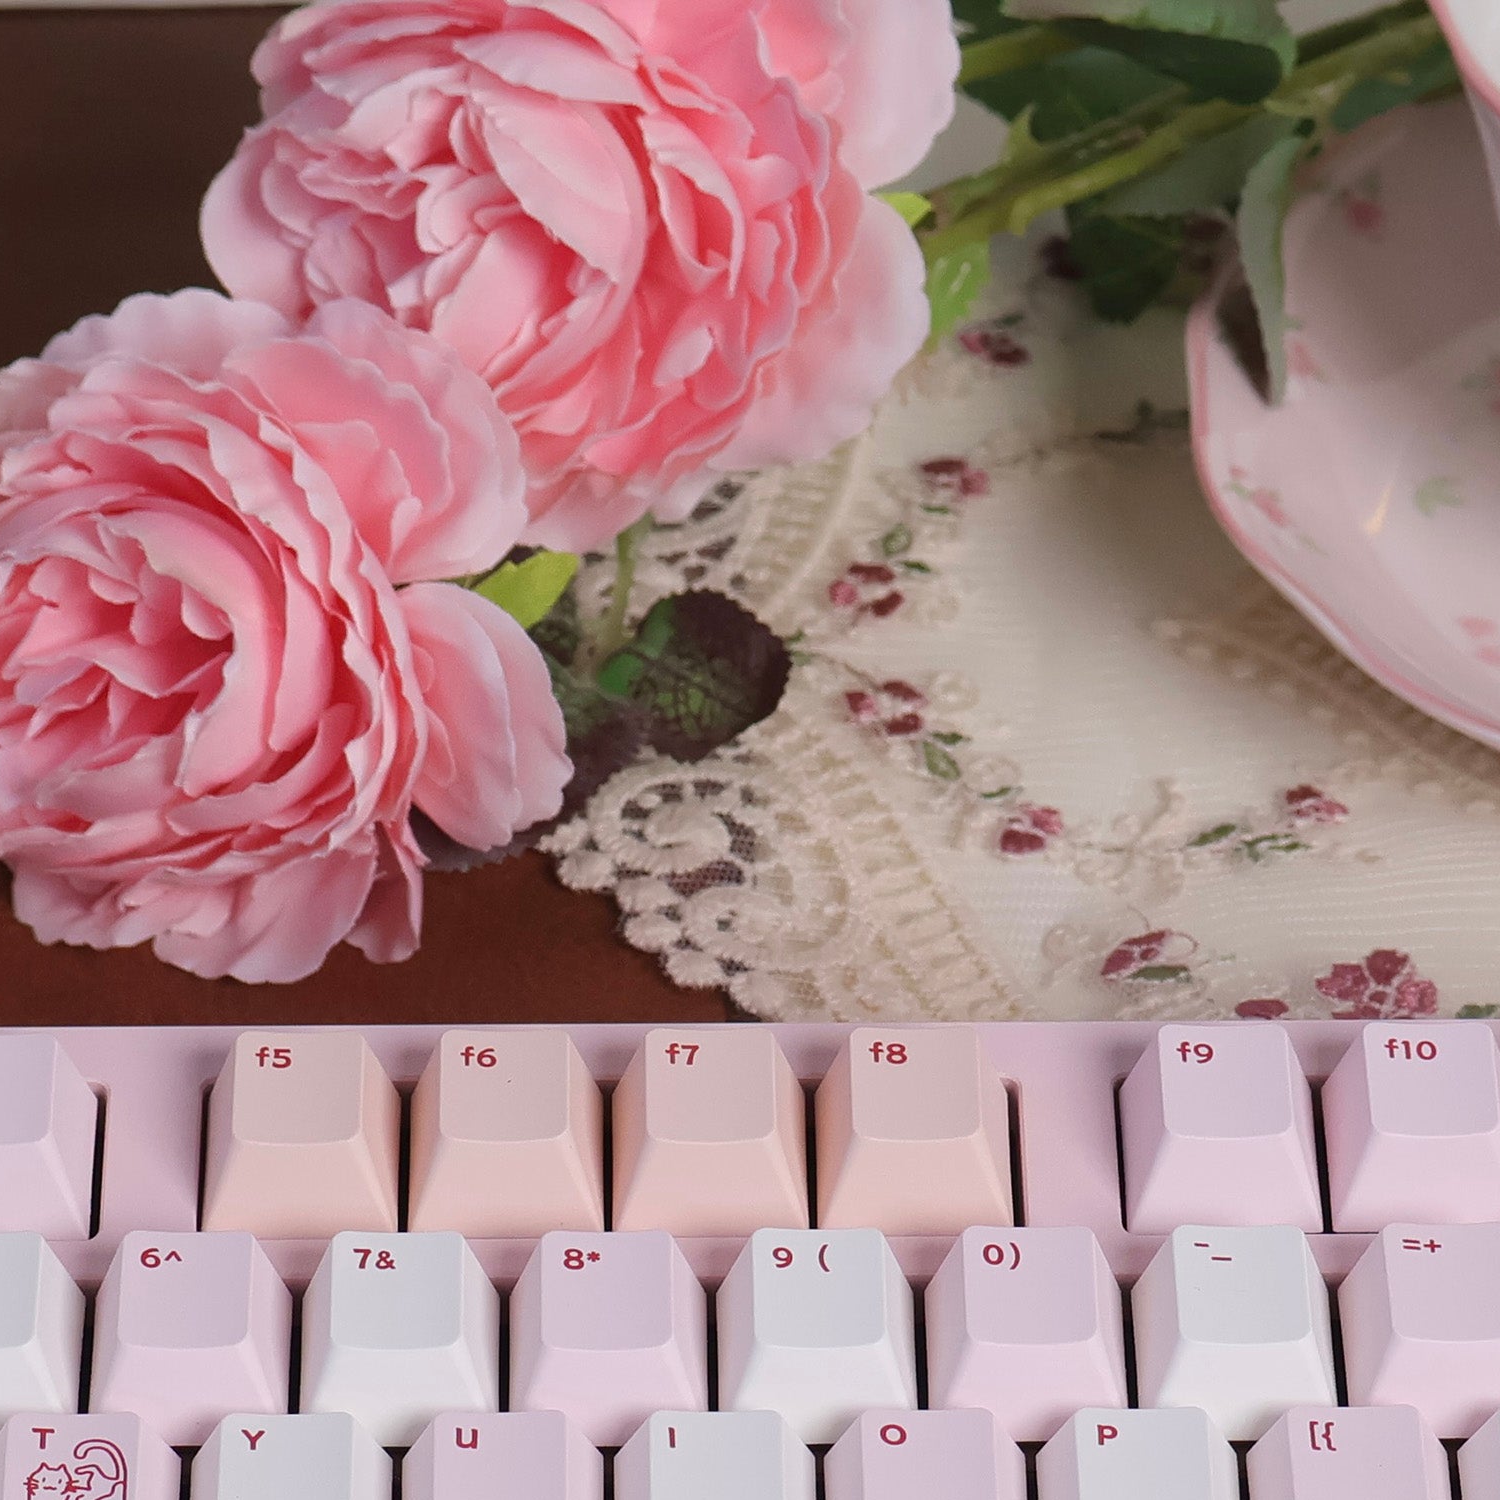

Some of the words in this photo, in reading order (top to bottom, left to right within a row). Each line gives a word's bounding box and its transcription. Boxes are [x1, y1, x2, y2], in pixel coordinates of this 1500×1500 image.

[254, 1045, 293, 1070] f5
[459, 1044, 498, 1069] f6
[663, 1041, 701, 1067] f7
[867, 1040, 909, 1066] f8
[1175, 1040, 1215, 1065] f9
[1383, 1037, 1438, 1062] f10
[139, 1246, 184, 1270] 6^
[352, 1247, 397, 1271] 7&
[771, 1246, 794, 1270] 9
[981, 1241, 1022, 1271] 0)
[30, 1426, 56, 1451] T
[240, 1428, 267, 1452] Y
[454, 1426, 480, 1451] U
[878, 1423, 908, 1447] O
[1096, 1423, 1119, 1447] P
